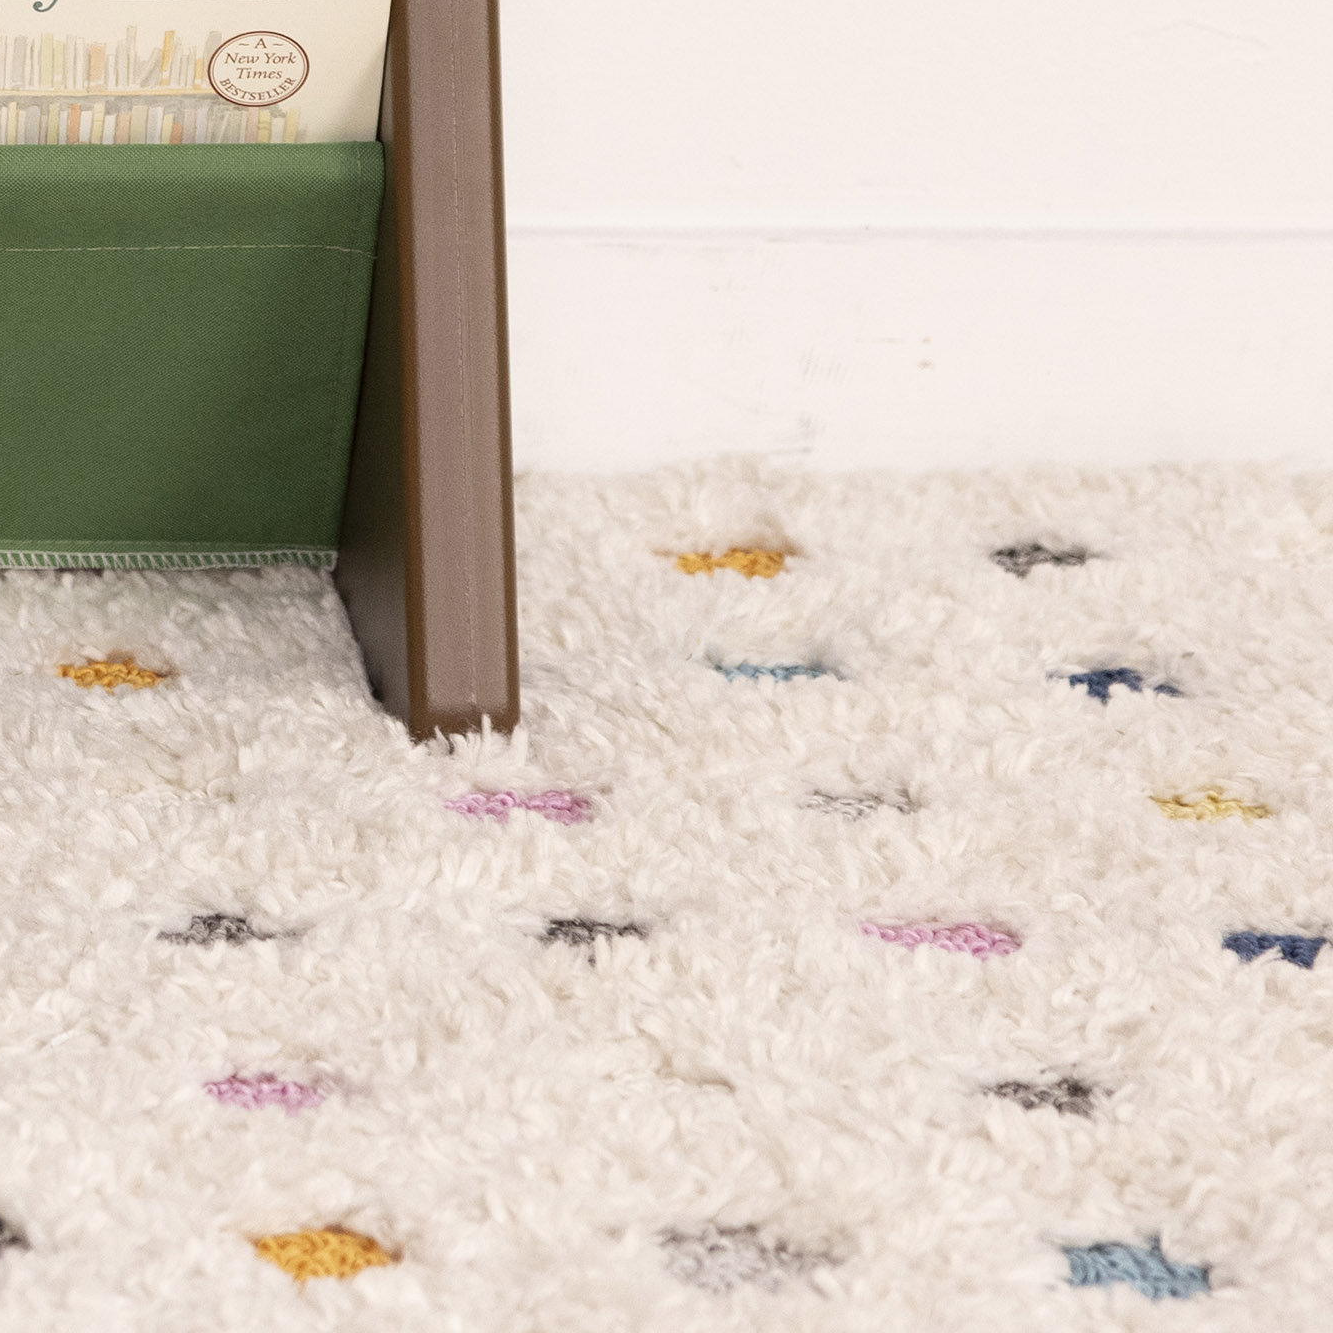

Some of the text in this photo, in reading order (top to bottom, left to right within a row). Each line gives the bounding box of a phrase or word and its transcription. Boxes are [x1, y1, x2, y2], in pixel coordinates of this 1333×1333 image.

[254, 37, 267, 49] A
[224, 51, 297, 64] New York
[236, 67, 283, 79] Times
[219, 77, 297, 101] BESTSELLER
